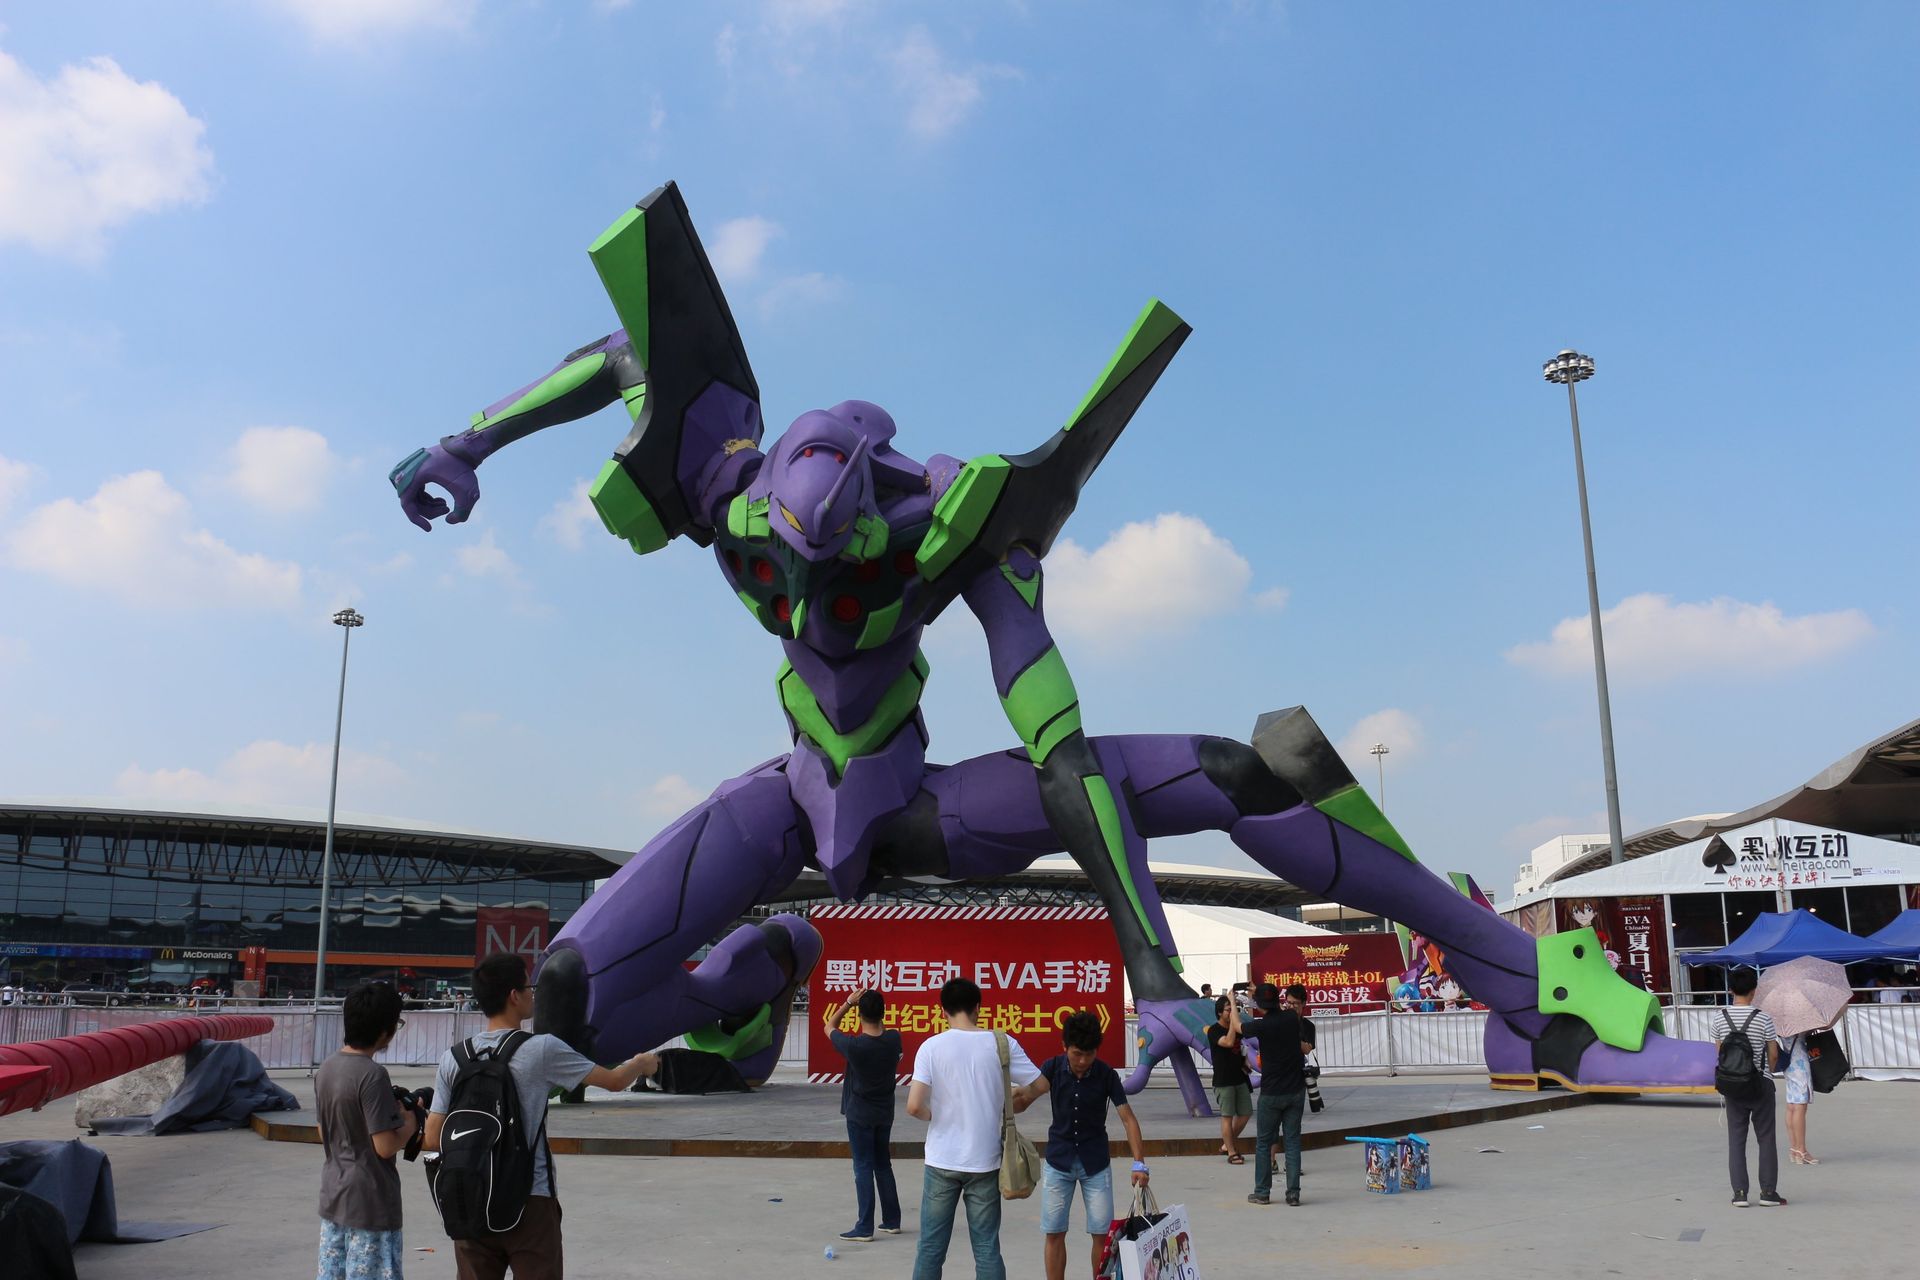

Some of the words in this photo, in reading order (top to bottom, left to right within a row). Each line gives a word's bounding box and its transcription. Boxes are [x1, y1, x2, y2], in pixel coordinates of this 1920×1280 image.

[1740, 833, 1849, 862] 黑桃互动
[1740, 859, 1851, 873] wwwheitao.com
[1624, 915, 1651, 925] EVA
[182, 951, 233, 960] McDonald's
[824, 959, 961, 993] 黑桃互动
[975, 960, 1111, 993] EVA手游
[1263, 971, 1385, 987] 新世纪福音战士OL
